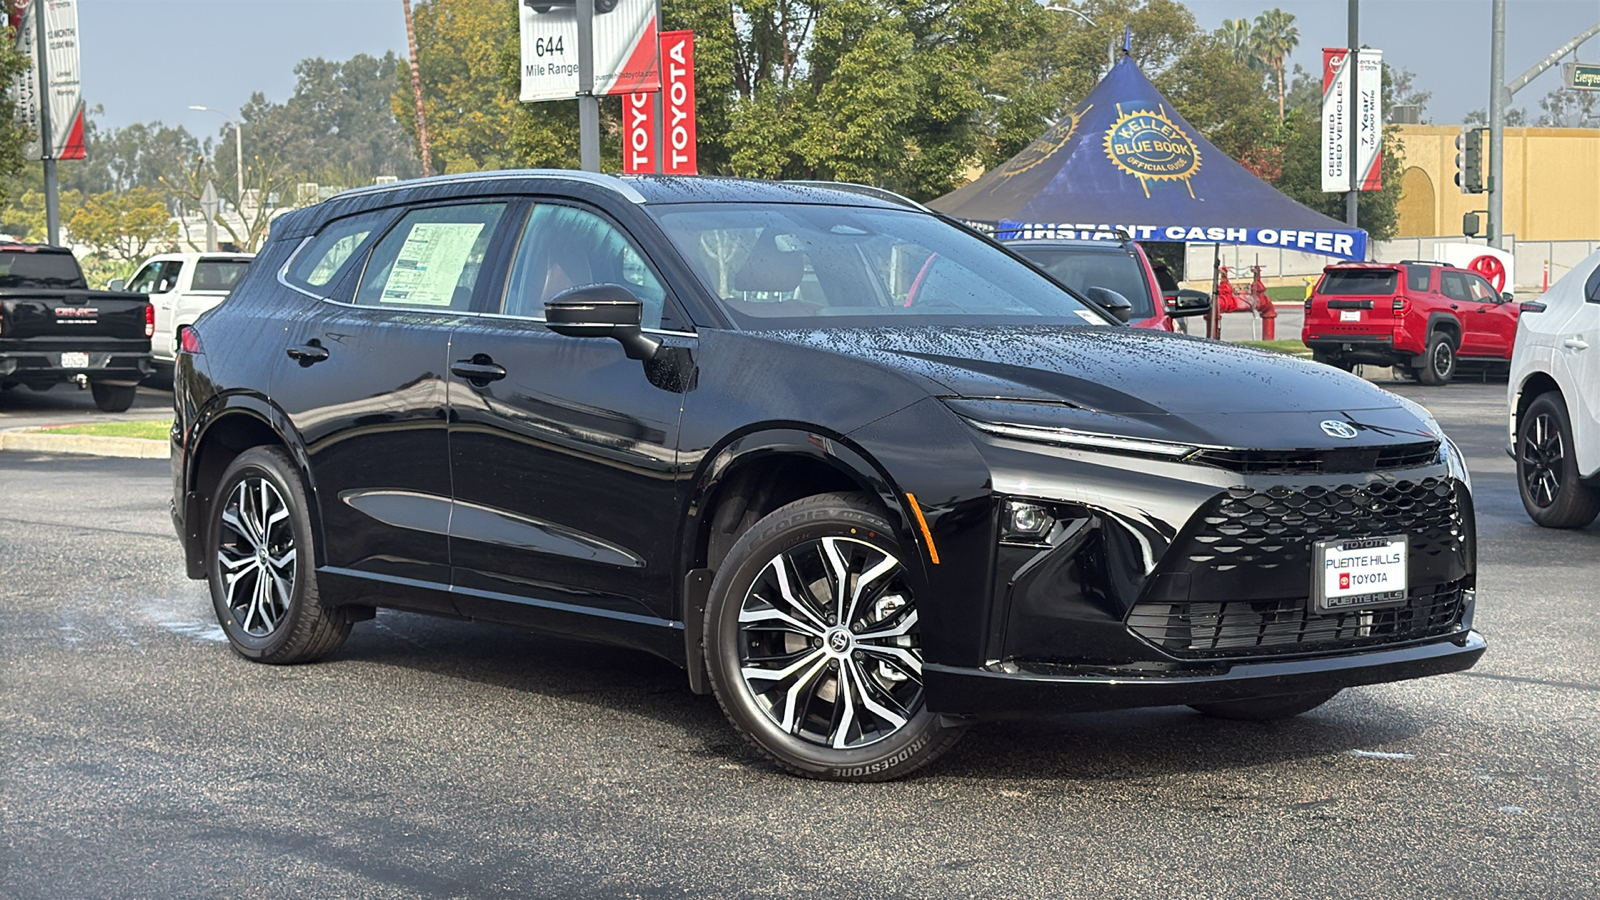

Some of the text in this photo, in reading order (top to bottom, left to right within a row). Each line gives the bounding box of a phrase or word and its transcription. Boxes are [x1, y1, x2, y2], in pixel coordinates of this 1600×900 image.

[536, 35, 564, 57] 644
[526, 63, 579, 77] Mile Range
[669, 40, 688, 170] TOYOTA
[1118, 118, 1181, 139] KELLEY
[1114, 140, 1192, 156] BLUE BOOK
[1126, 156, 1187, 171] OFFICIAL GUIDE
[1023, 223, 1354, 256] INSTANT CASH OFFER
[55, 307, 98, 317] GMC
[1343, 540, 1387, 550] TOYOTA
[1326, 554, 1400, 569] PUENTE HILLS
[1352, 573, 1387, 585] TOYOTA
[1329, 592, 1403, 606] PUENTE HILLS
[833, 731, 931, 777] BRIDGESTONE
